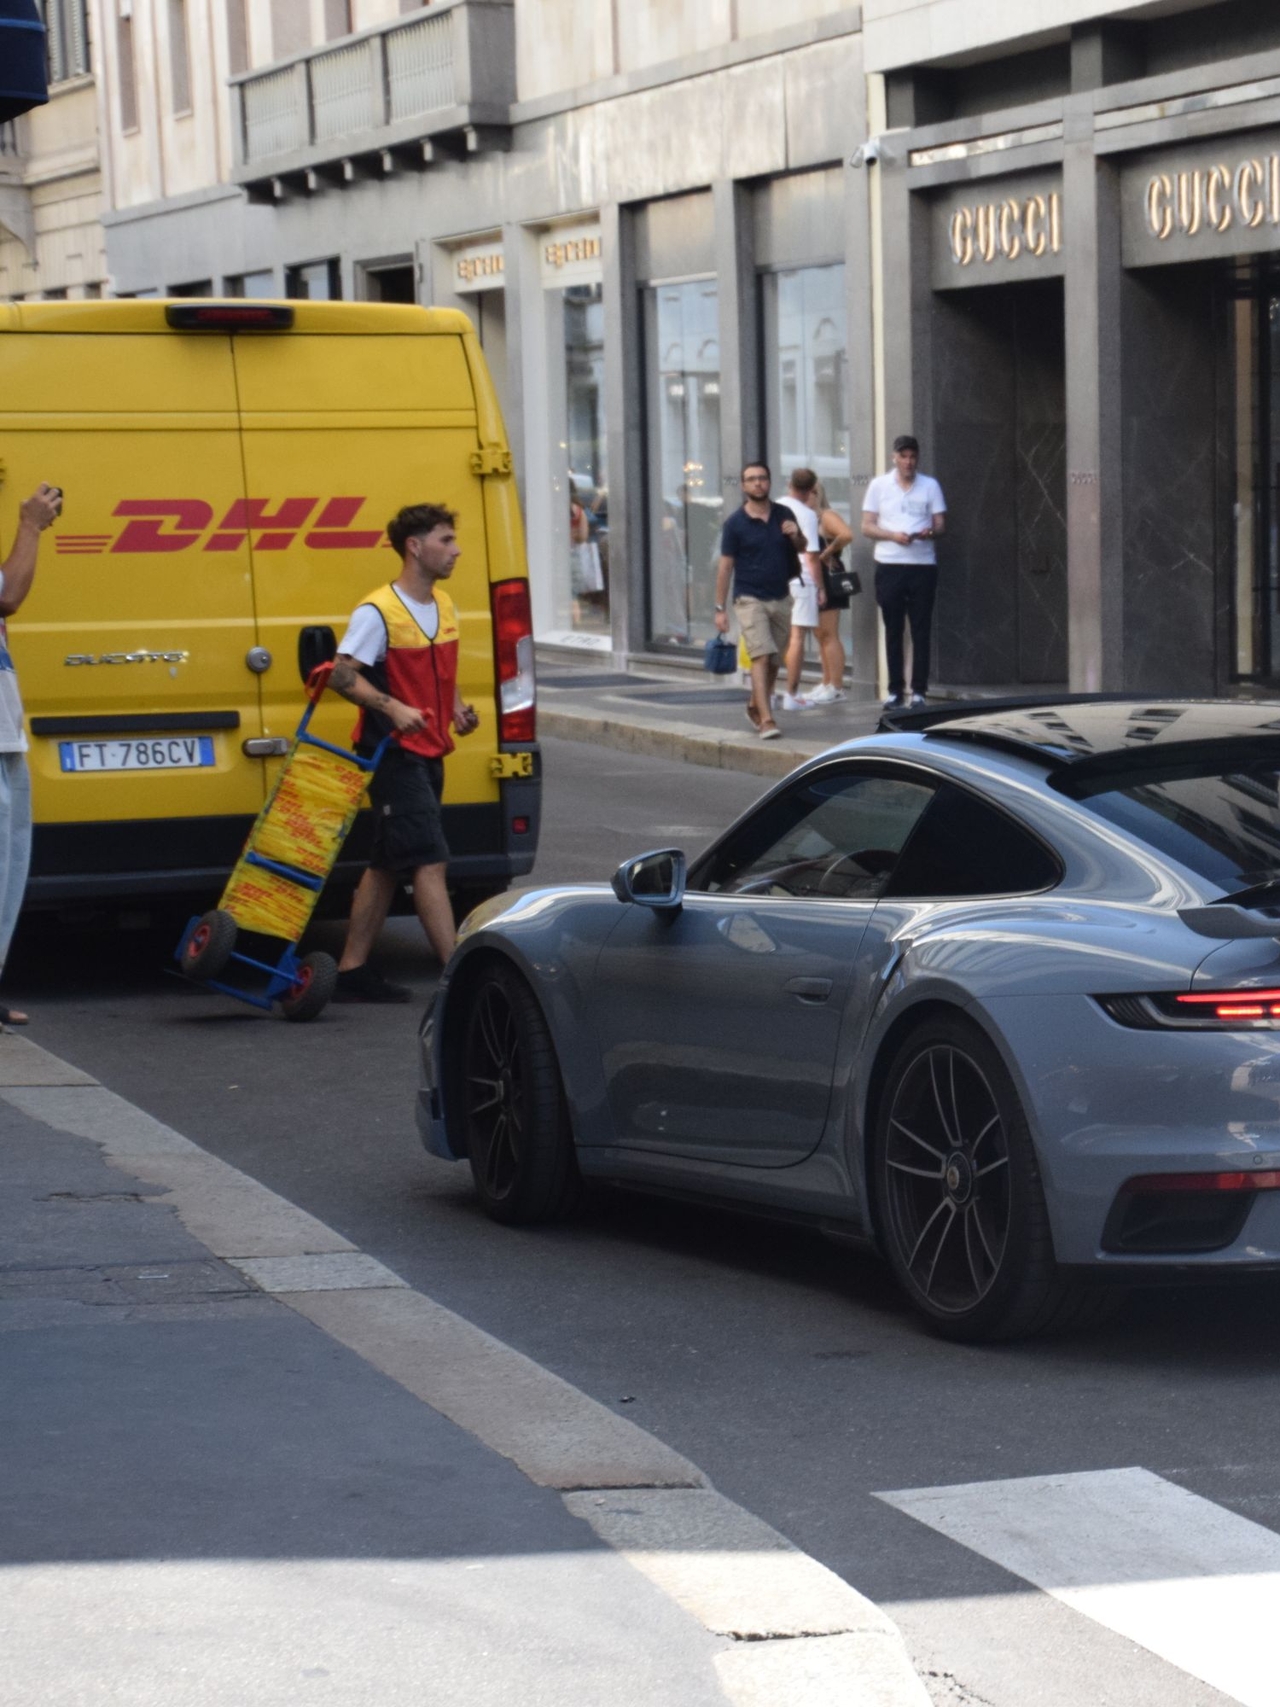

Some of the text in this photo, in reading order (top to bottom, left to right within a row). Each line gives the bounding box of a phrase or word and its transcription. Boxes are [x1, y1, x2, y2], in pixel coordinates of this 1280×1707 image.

[950, 191, 1060, 267] GUCCI
[1146, 154, 1280, 240] GUCCI
[109, 496, 384, 553] DHL
[78, 740, 195, 767] FT 786CV
